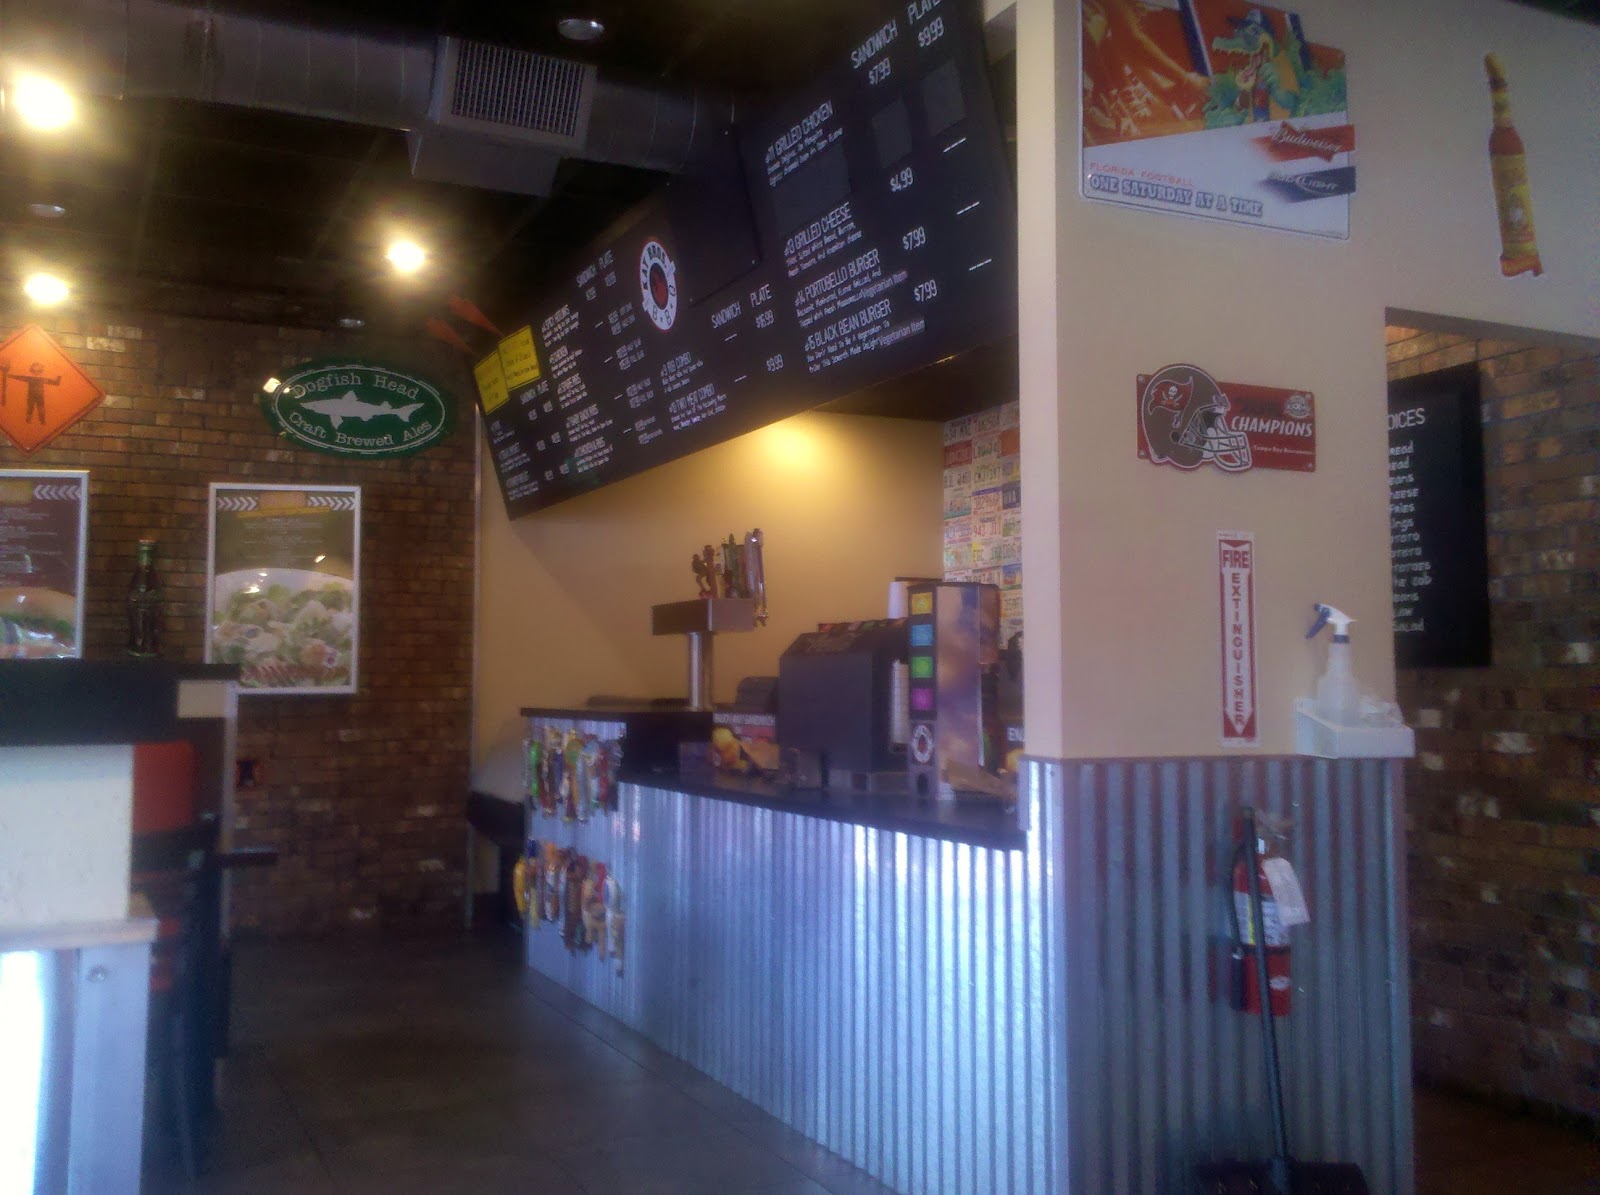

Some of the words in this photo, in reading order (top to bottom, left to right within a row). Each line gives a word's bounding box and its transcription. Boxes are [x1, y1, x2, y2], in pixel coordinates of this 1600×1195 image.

[851, 19, 898, 69] SANDWICH
[1089, 162, 1134, 177] FLORIDA
[1090, 173, 1119, 193] ONE
[1121, 179, 1192, 206] SATURDAY
[1196, 192, 1214, 209] AT
[1216, 194, 1227, 211] A
[1230, 197, 1264, 218] TIME
[795, 222, 822, 250] GRILLED
[821, 201, 852, 233] CHEESE
[902, 226, 926, 251] $7.99
[805, 266, 848, 302] PORTOBELLO
[847, 248, 880, 278] BURGER
[750, 283, 772, 308] PLATE
[914, 279, 938, 303] $7.99
[815, 322, 839, 348] BLACK
[838, 314, 860, 337] BEAN
[859, 298, 892, 327] BURGER
[289, 372, 363, 399] Dogfish
[373, 374, 419, 400] Head
[289, 412, 327, 439] Craft
[335, 432, 394, 447] Brewed
[403, 420, 433, 442] Ales
[1231, 416, 1313, 437] CHAMPIONS
[1222, 551, 1249, 568] FIRE
[1231, 573, 1245, 726] EXTINGUISHER
